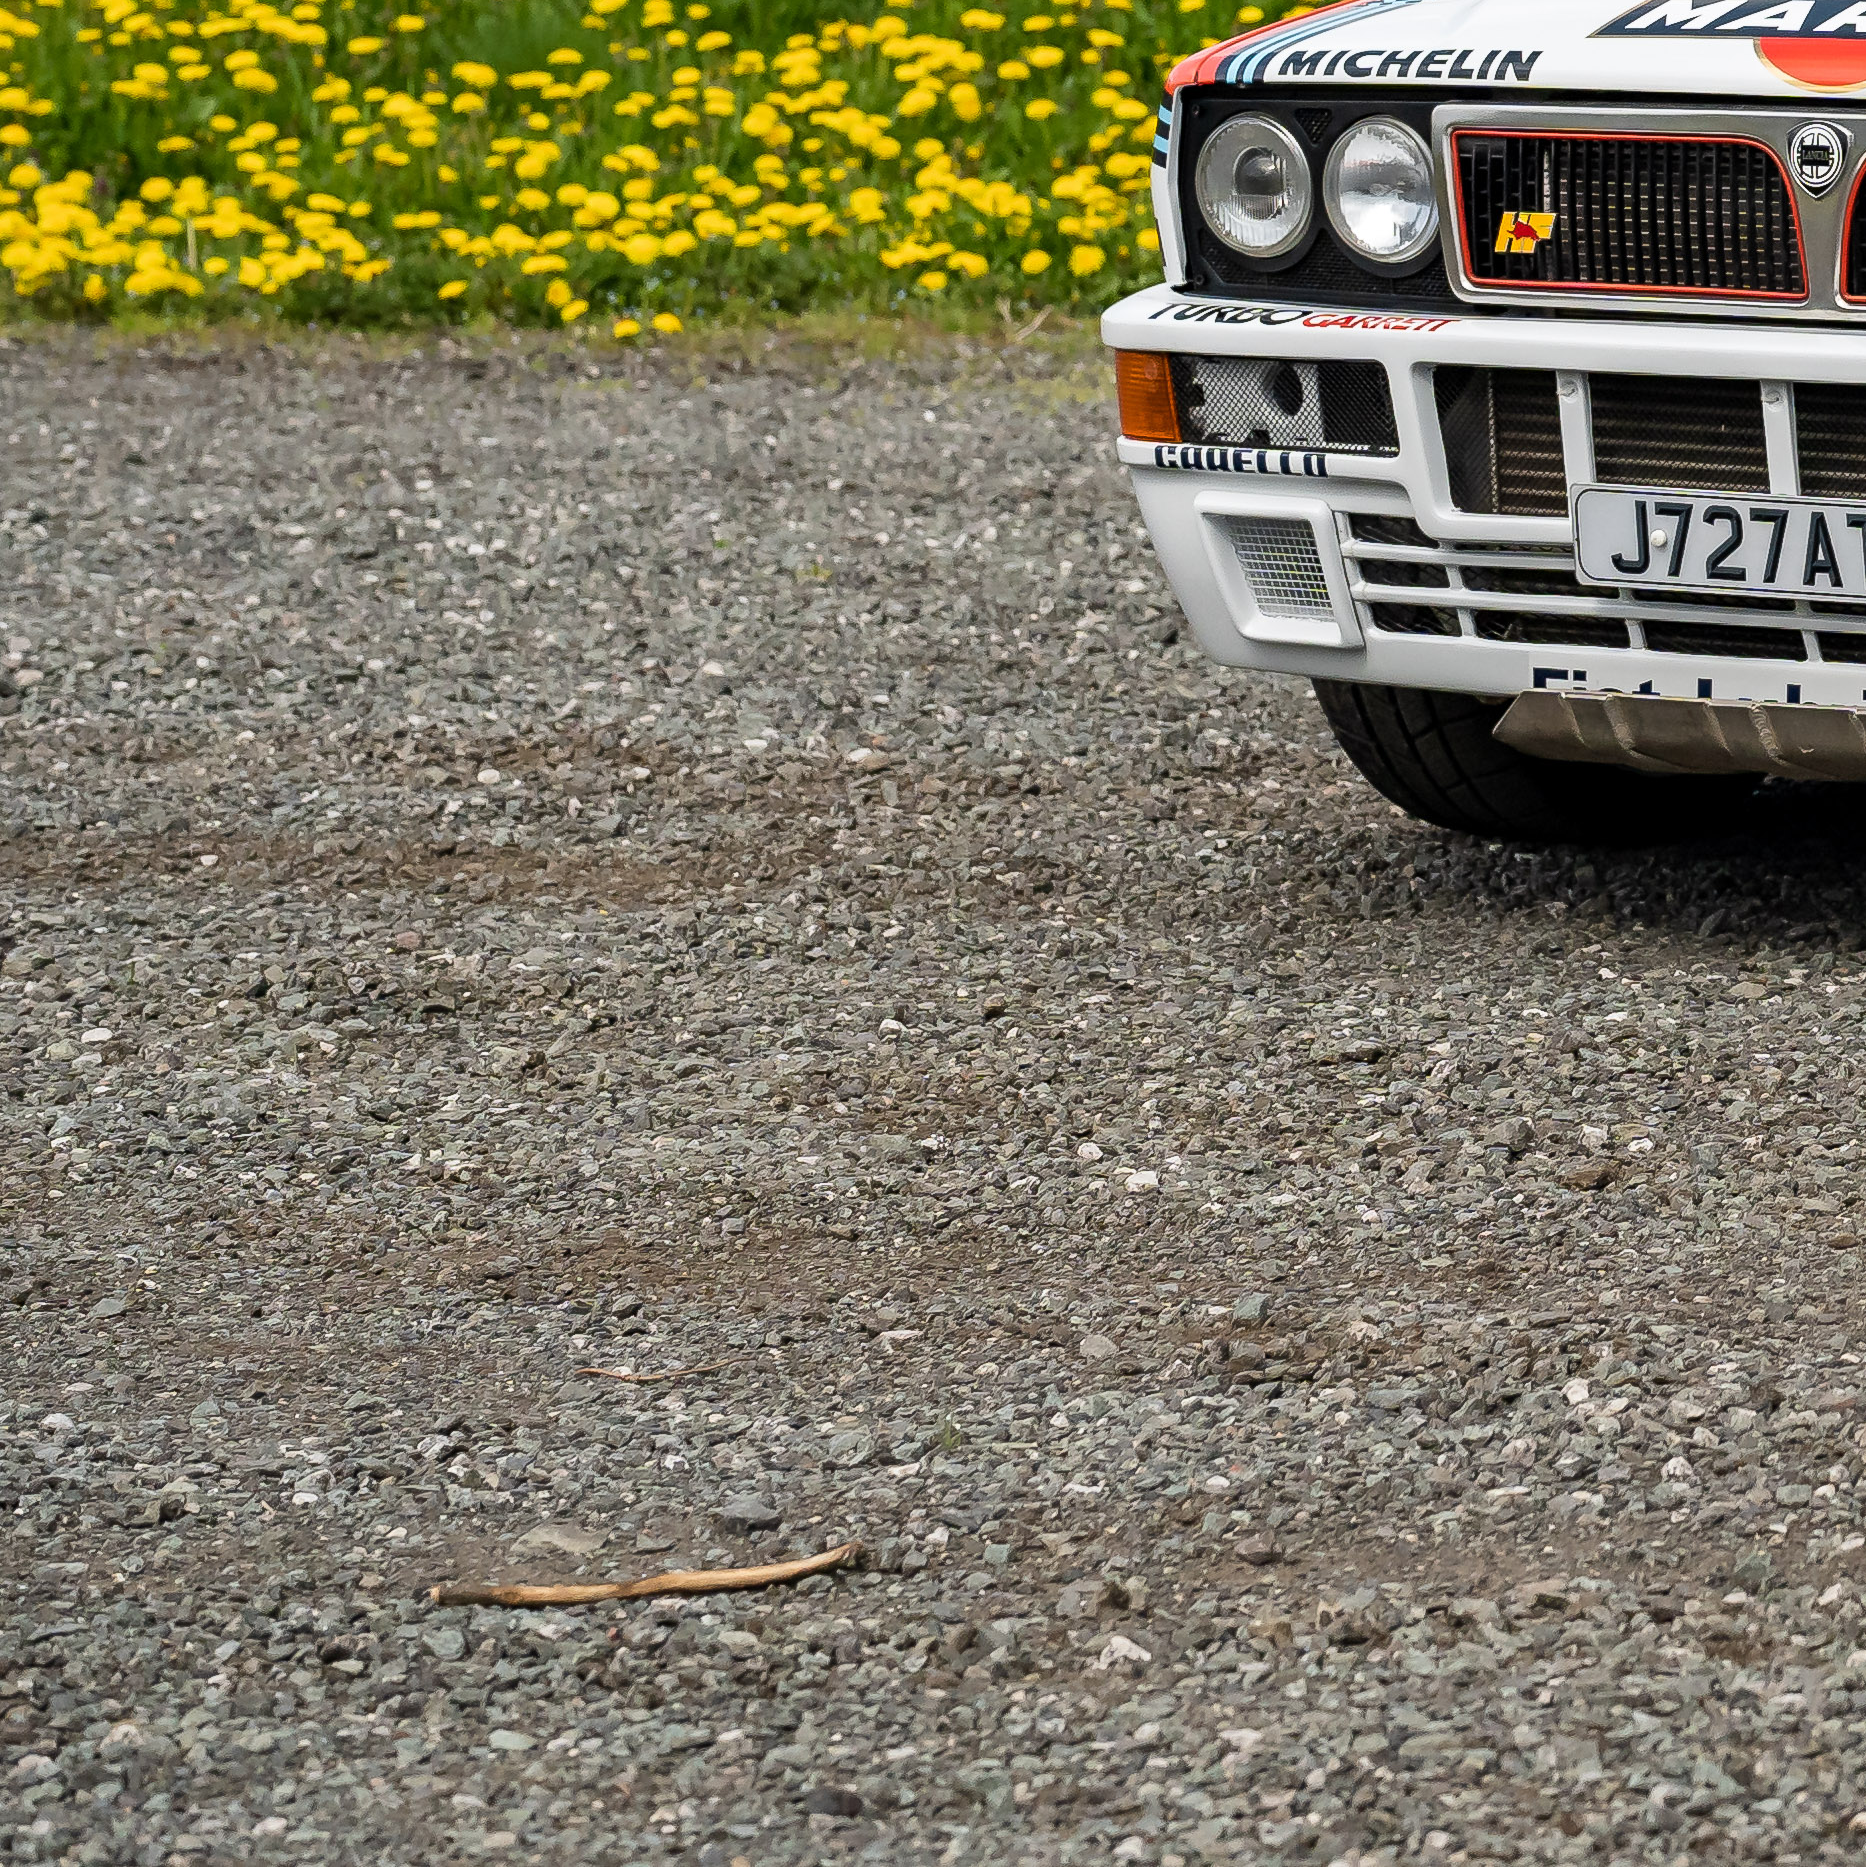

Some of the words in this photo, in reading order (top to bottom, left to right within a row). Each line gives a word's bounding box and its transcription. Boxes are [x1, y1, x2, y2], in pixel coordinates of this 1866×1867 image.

[1278, 49, 1543, 81] MICHELIN
[1148, 302, 1313, 325] TURBO
[1302, 314, 1461, 332] GARRETT
